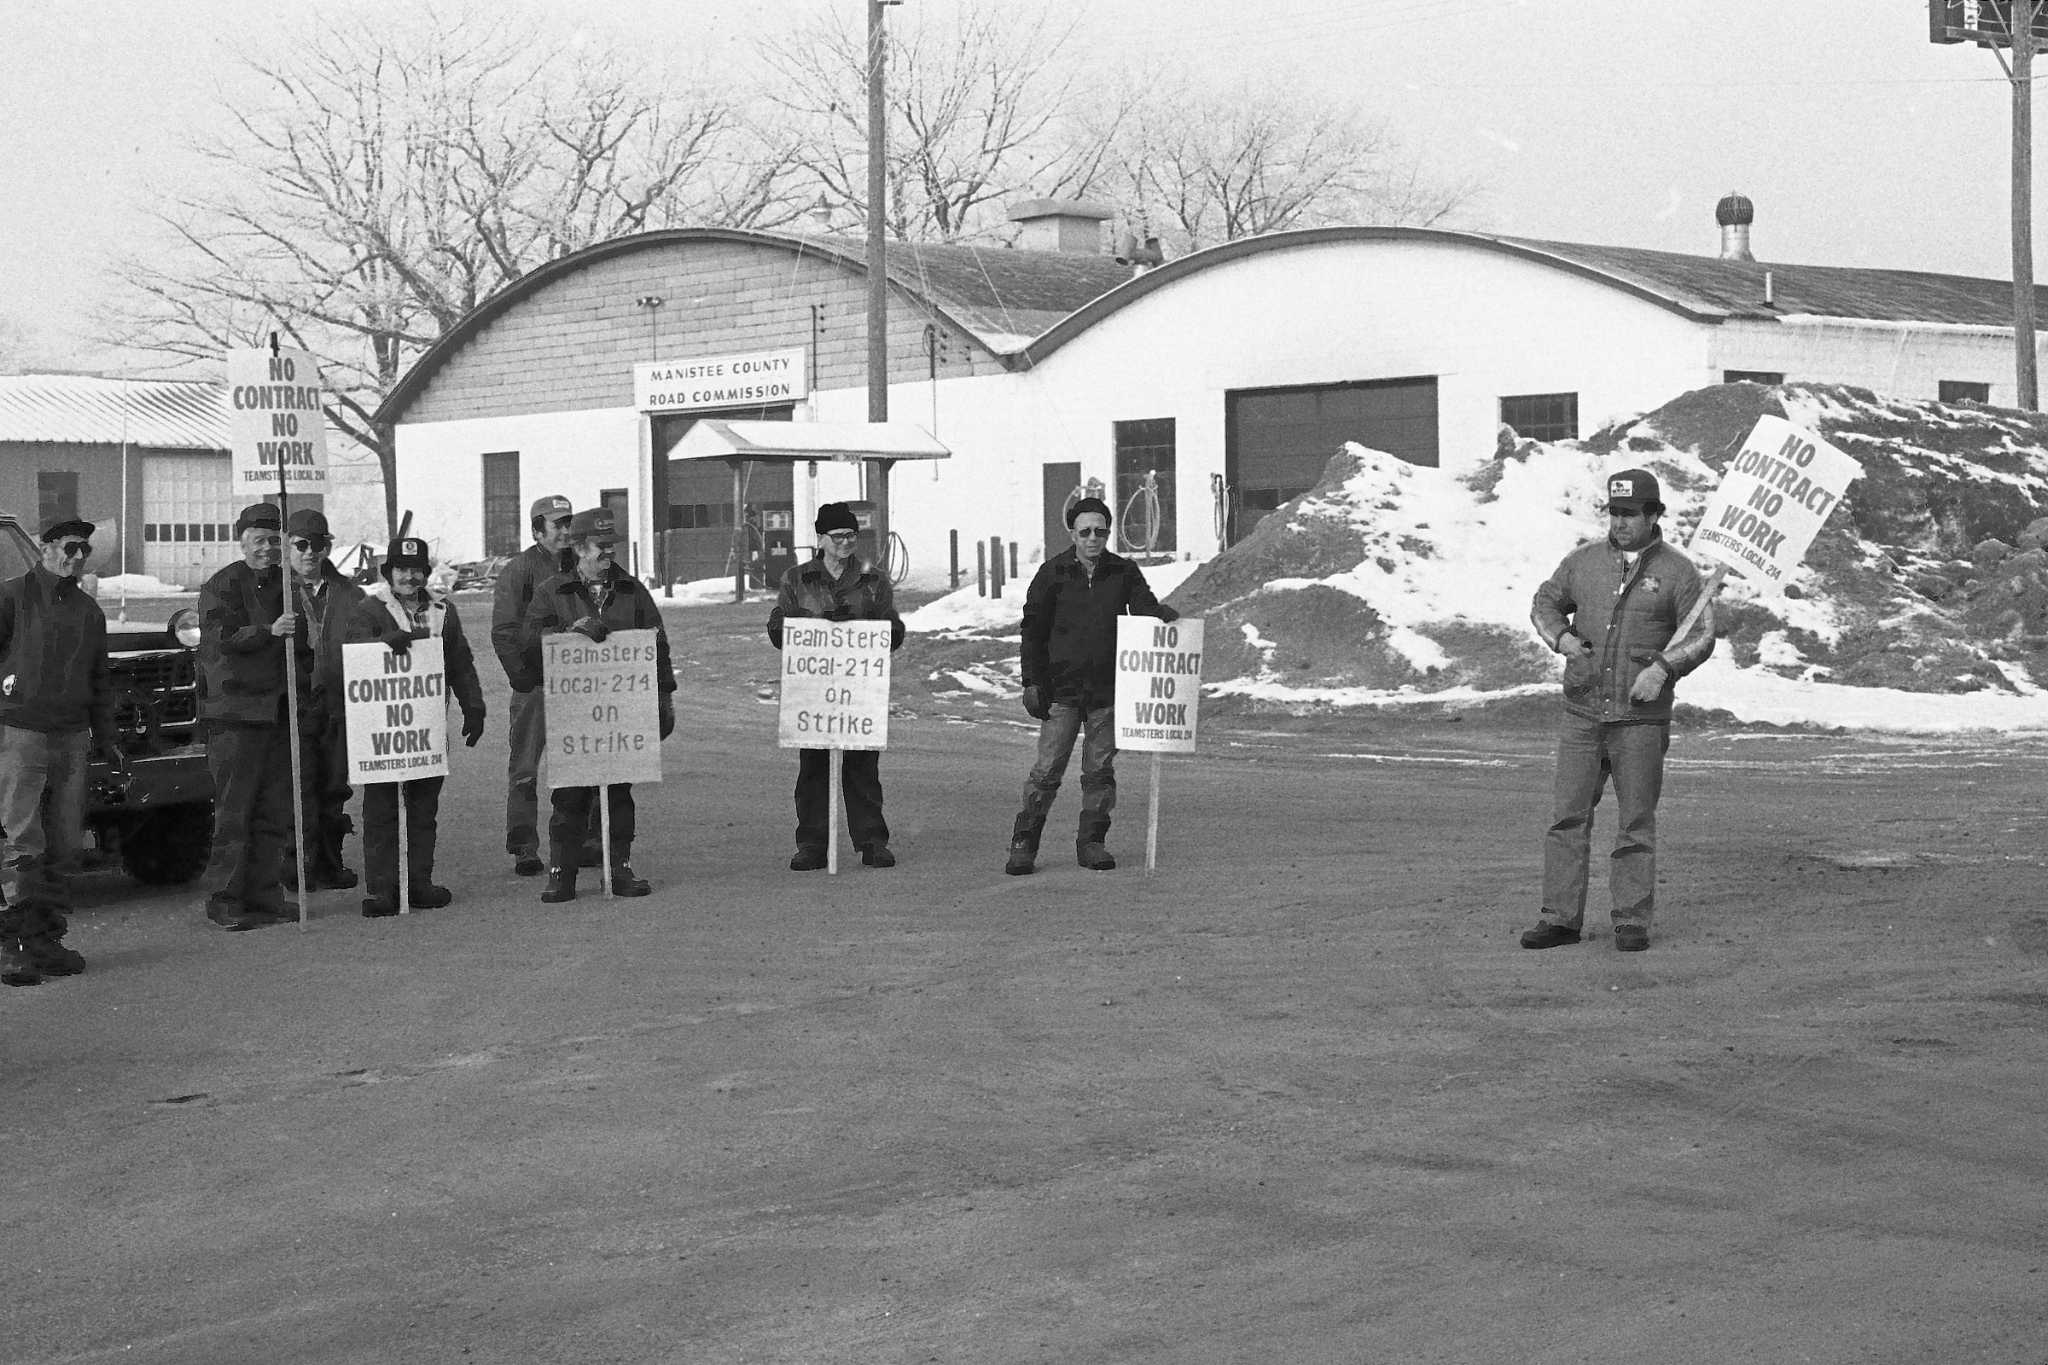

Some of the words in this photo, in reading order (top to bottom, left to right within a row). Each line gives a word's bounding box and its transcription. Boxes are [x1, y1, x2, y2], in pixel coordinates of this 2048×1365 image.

[269, 357, 295, 382] NO
[651, 364, 724, 381] MANISTEE
[732, 358, 790, 374] COUNTY
[233, 385, 321, 411] CONTRACT
[650, 392, 685, 406] ROAD
[692, 383, 790, 403] COMMISSION
[272, 413, 298, 437] NO
[257, 441, 314, 465] WORK
[1778, 433, 1816, 468] NO
[1734, 449, 1836, 516] CONTRACT
[1747, 484, 1784, 518] NO
[1719, 504, 1786, 558] WORK
[1740, 546, 1767, 572] LOCAL
[1765, 563, 1782, 581] 214
[1153, 626, 1178, 648] NO
[383, 650, 412, 674] NO
[546, 642, 655, 665] Teamsters
[1120, 650, 1201, 675] CONTRACT
[348, 673, 443, 703] CONTRACT
[825, 687, 852, 706] on
[1150, 677, 1176, 699] NO
[386, 703, 414, 727] NO
[592, 705, 619, 722] on
[797, 710, 873, 735] Strike
[1135, 702, 1187, 725] WORK
[371, 728, 432, 755] WORK
[358, 758, 407, 772] TEAMSTERS
[407, 756, 429, 768] LOCAL
